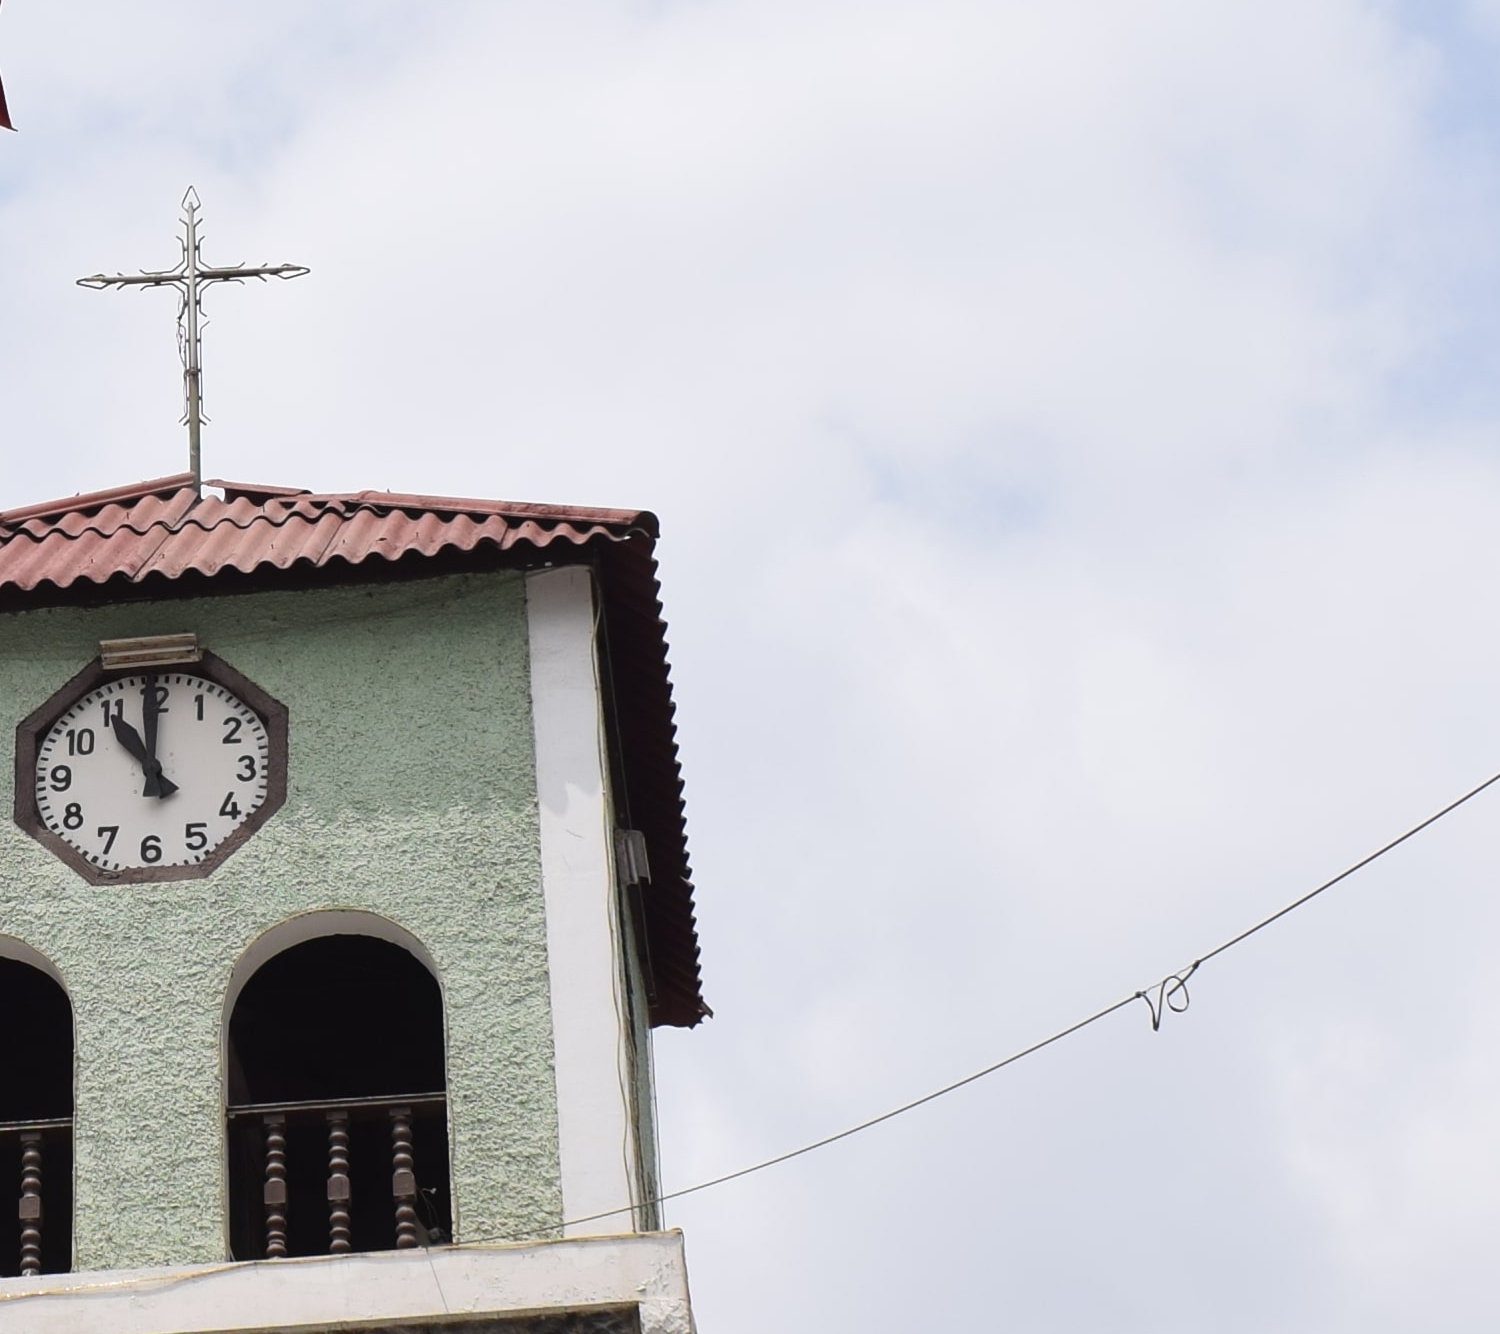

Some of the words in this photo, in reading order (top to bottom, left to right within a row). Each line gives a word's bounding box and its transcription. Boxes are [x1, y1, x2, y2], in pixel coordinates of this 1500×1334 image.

[100, 698, 124, 727] 11
[140, 686, 170, 713] 2
[194, 694, 204, 721] 1
[65, 728, 95, 756] 10
[222, 717, 242, 744] 2
[50, 765, 72, 792] 9
[236, 755, 257, 782] 3
[63, 803, 84, 830] 8
[218, 792, 242, 820] 4
[97, 825, 120, 855] 7
[140, 835, 162, 863] 6
[185, 822, 208, 850] 5
